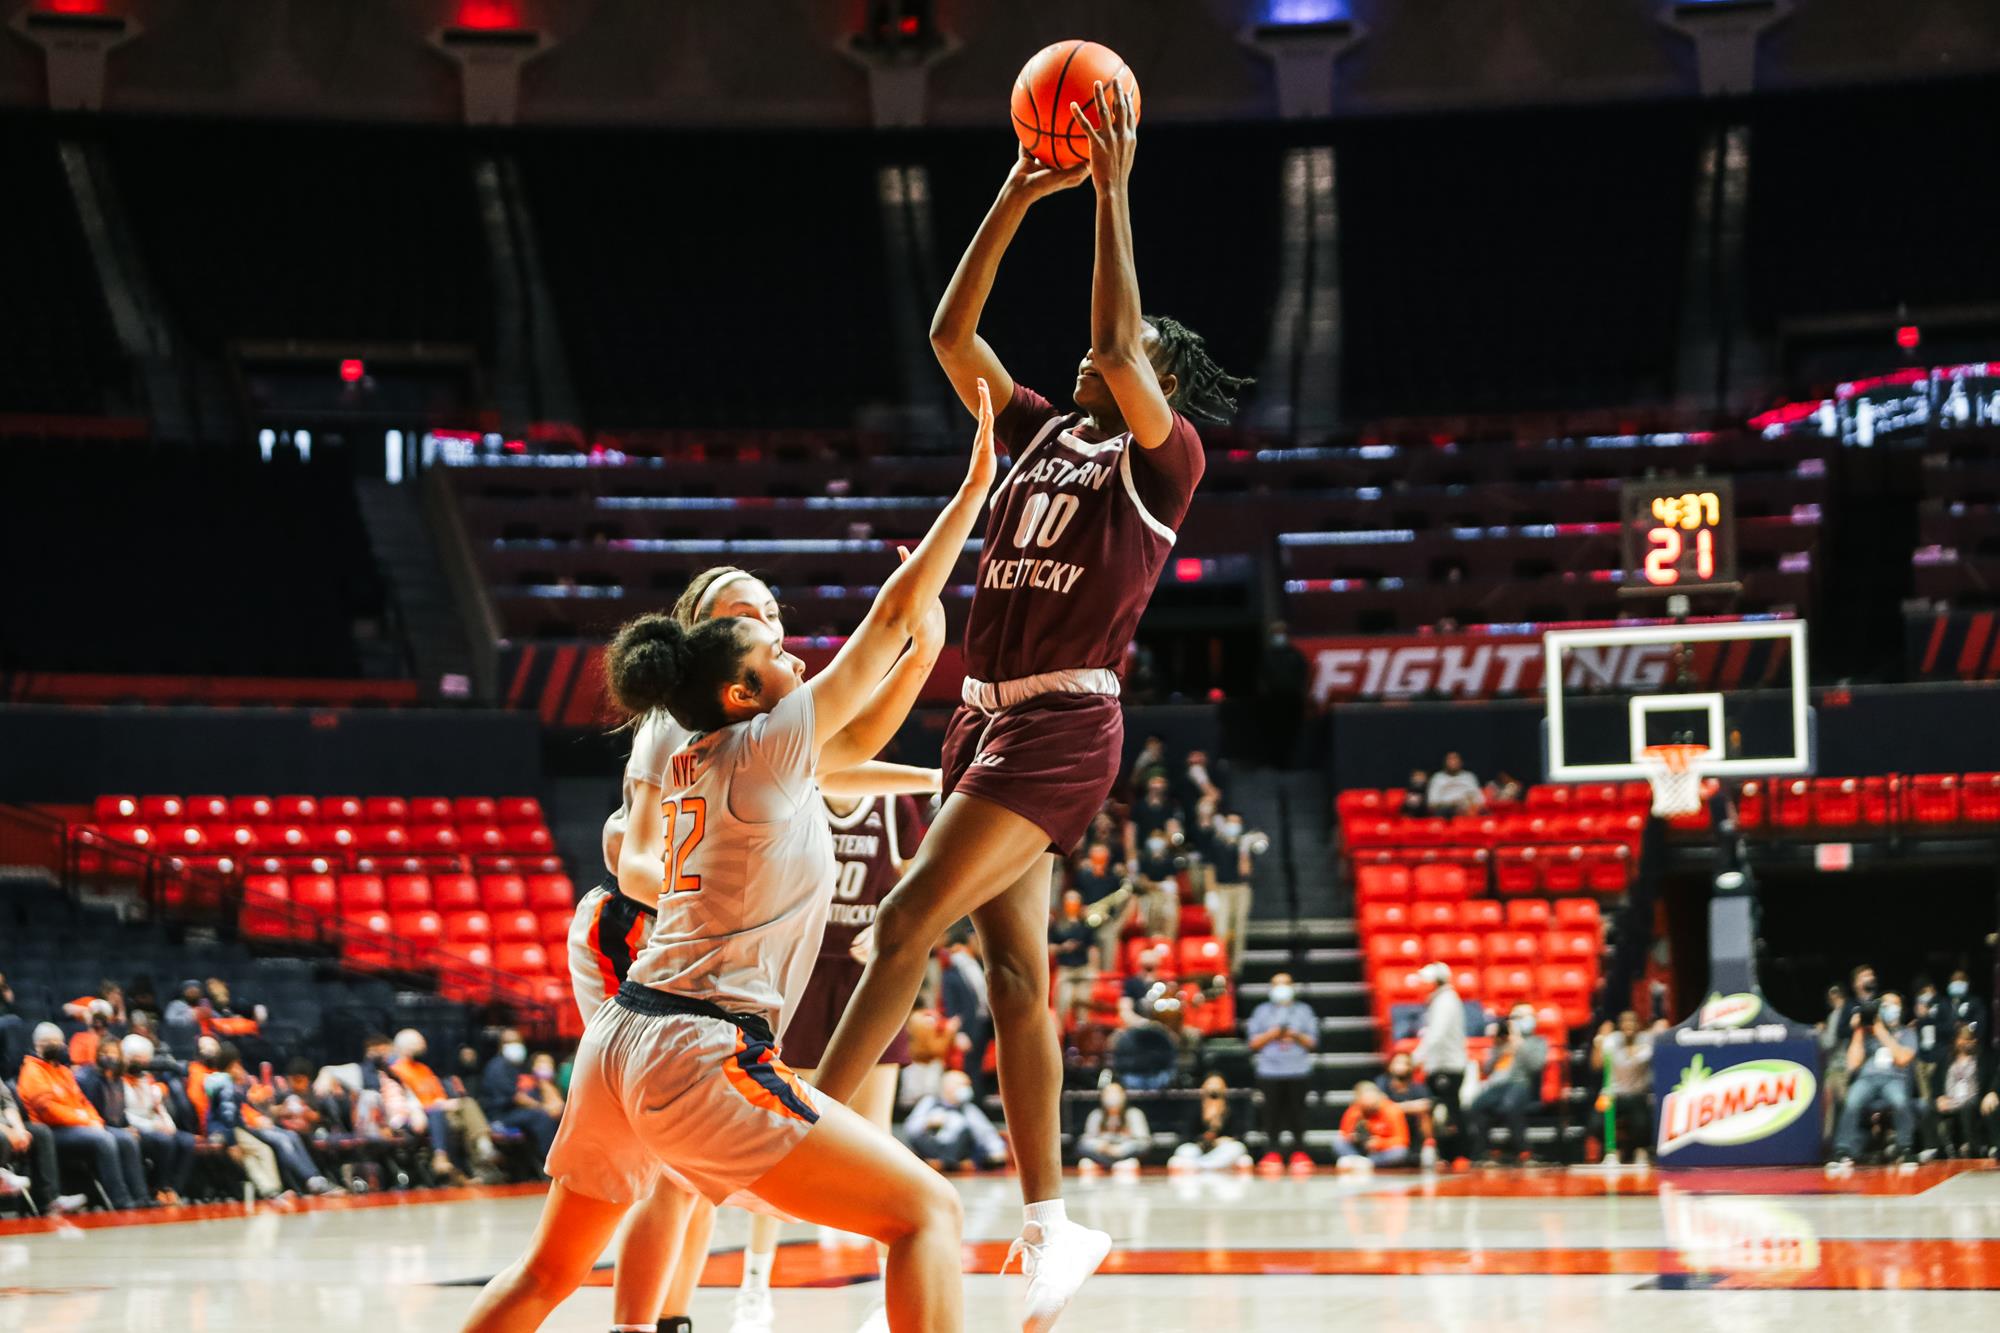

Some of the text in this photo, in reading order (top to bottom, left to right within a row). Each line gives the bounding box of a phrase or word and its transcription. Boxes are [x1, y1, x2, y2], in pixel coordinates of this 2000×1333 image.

[1013, 457, 1112, 490] ASTRN
[1013, 492, 1080, 549] 00
[1651, 492, 1721, 531] 4:37
[1644, 527, 1715, 586] 21
[1313, 643, 1675, 705] FIGHTNG
[672, 754, 697, 787] NYE
[832, 834, 880, 857] STERN
[1664, 1072, 1799, 1142] LIBMAN
